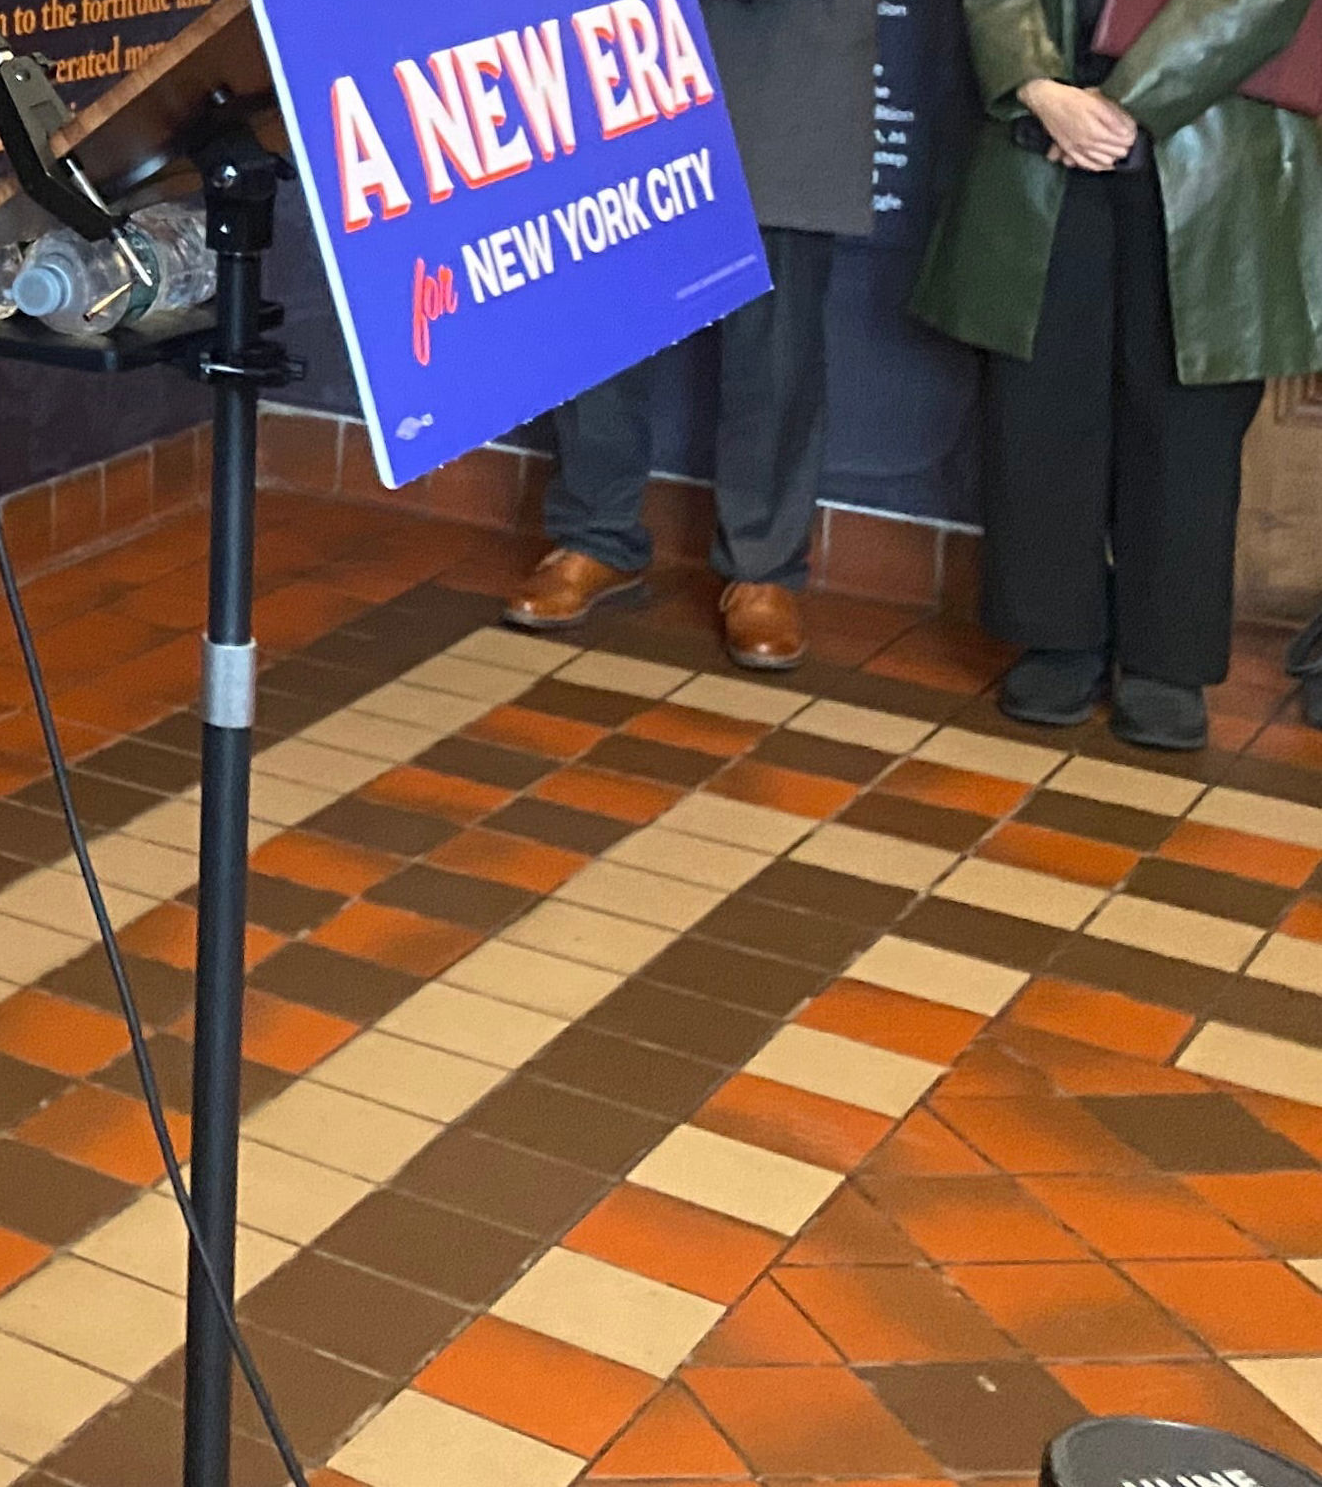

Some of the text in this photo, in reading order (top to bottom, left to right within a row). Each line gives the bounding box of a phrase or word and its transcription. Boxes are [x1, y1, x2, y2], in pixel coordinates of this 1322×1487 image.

[13, 4, 37, 36] to
[330, 75, 412, 233] A
[394, 19, 576, 203] NEW
[413, 147, 716, 366] for NEW YORK CITY
